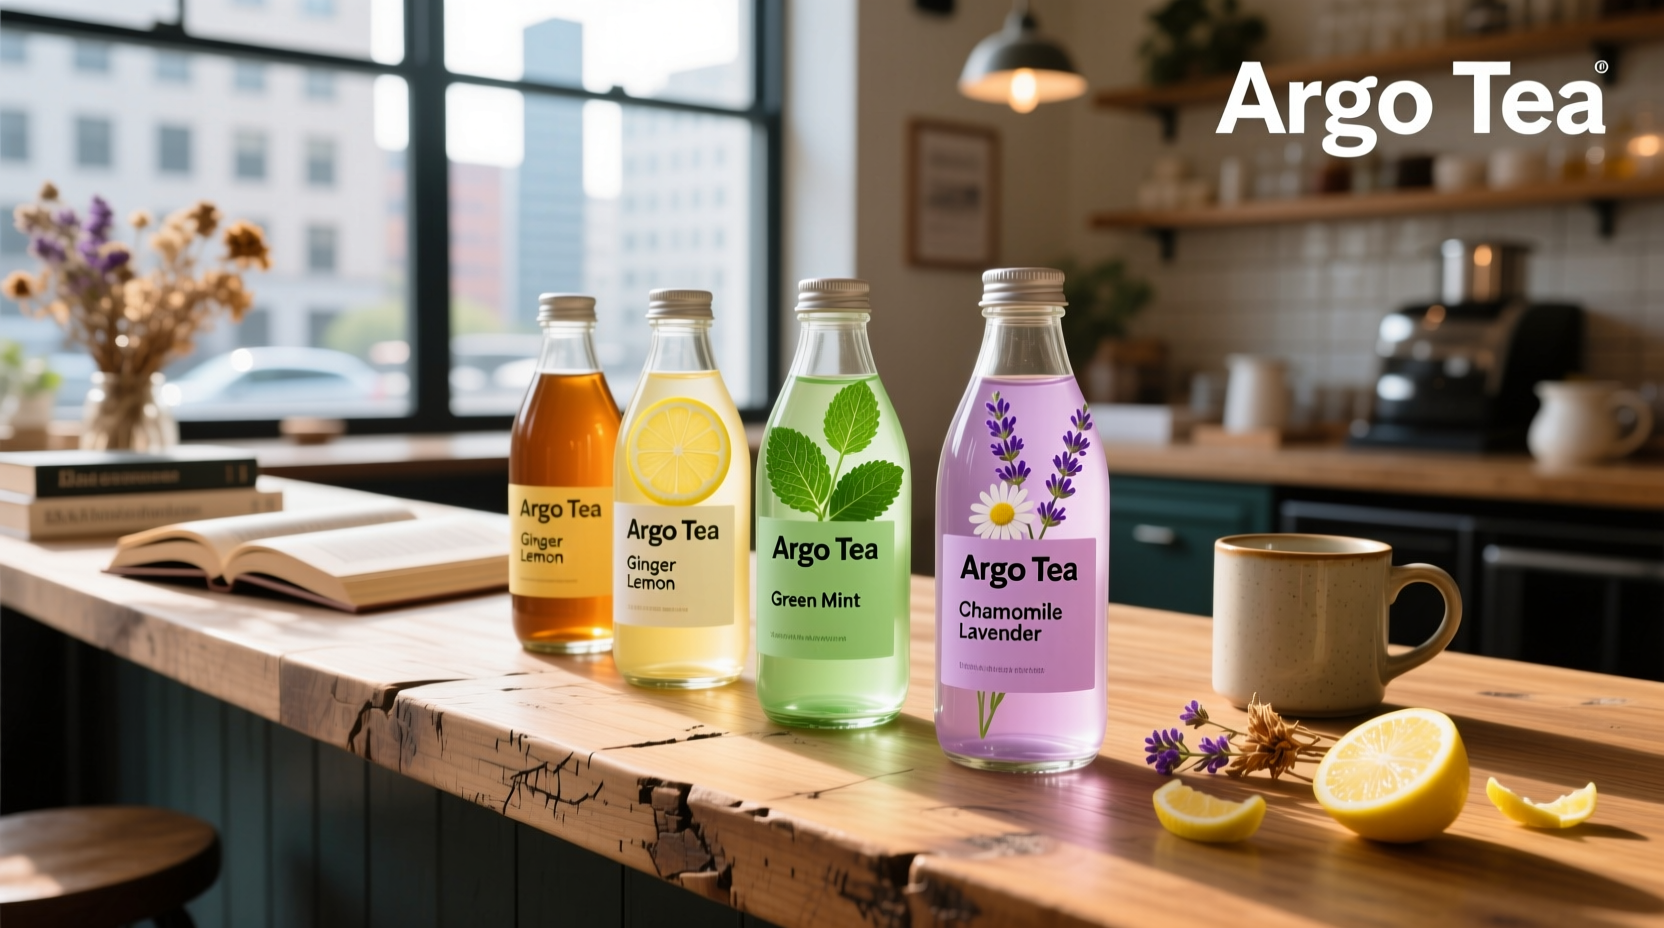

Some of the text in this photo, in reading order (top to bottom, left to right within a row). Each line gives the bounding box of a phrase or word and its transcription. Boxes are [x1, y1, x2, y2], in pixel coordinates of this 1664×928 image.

[520, 498, 602, 524] Argo Tea
[520, 532, 563, 550] Ginger
[627, 518, 719, 547] Argo Tea
[520, 548, 564, 564] Lemon
[772, 535, 879, 568] Argo Tea
[626, 555, 677, 576] Ginger
[960, 554, 1078, 589] Argo Tea
[627, 574, 676, 591] Lemon
[771, 590, 861, 609] Green Mint
[959, 600, 1063, 621] Chamomile
[959, 622, 1042, 642] Lavender
